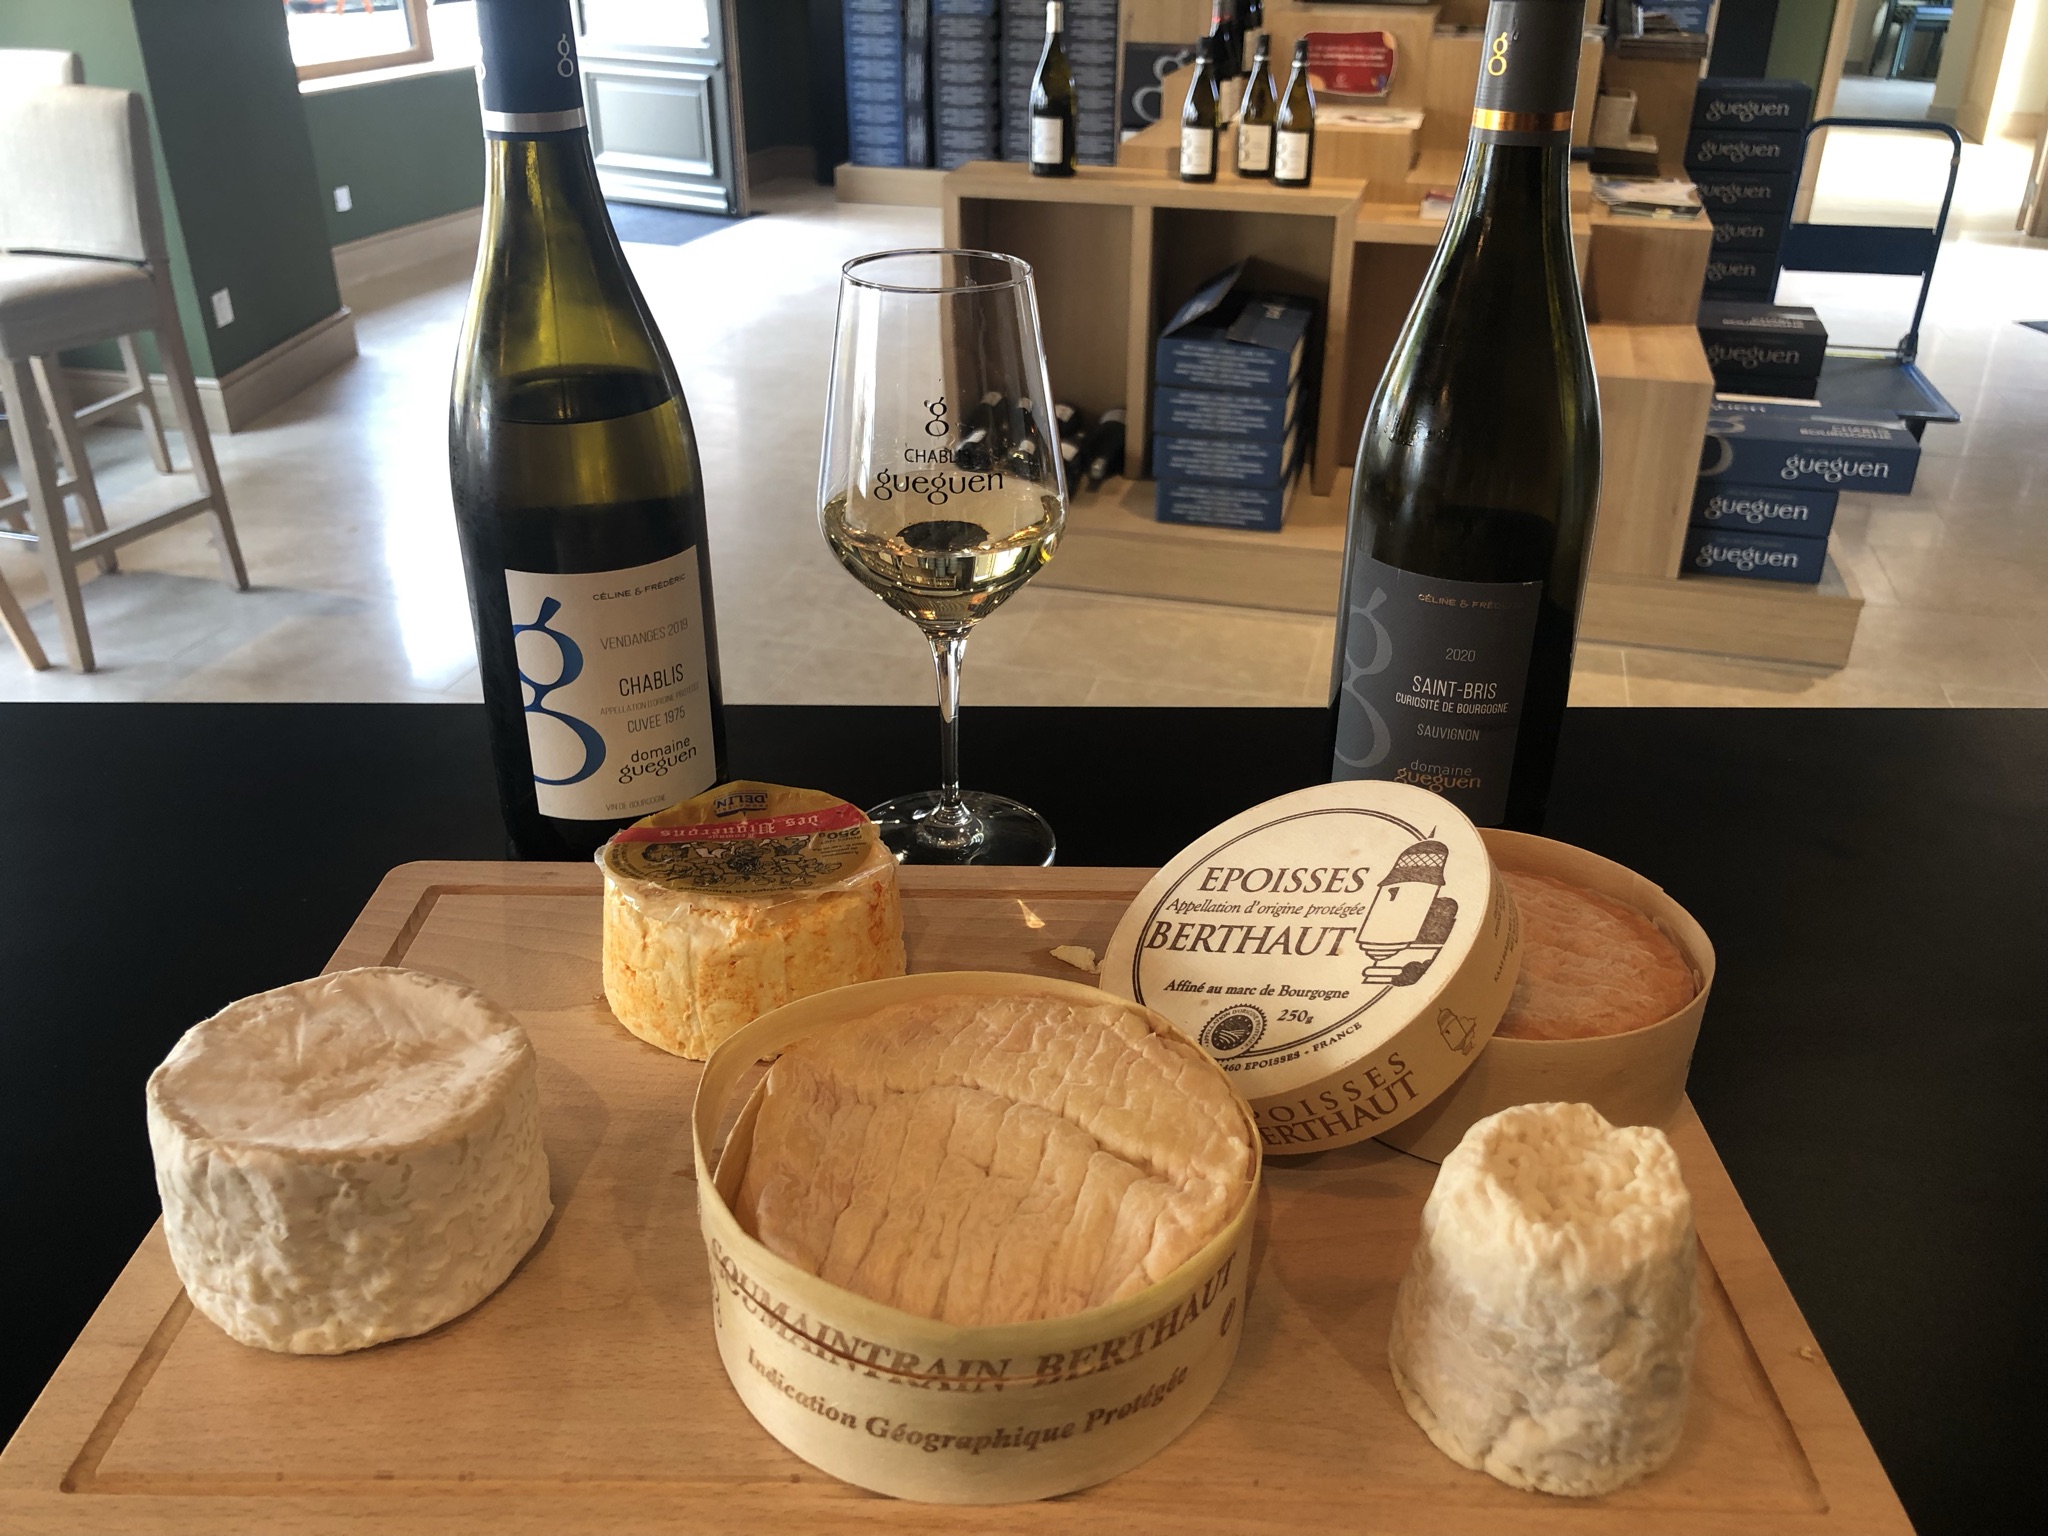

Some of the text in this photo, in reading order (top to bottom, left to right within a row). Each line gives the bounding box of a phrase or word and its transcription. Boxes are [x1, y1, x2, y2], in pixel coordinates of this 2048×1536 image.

[1706, 99, 1790, 122] gueguen
[1697, 140, 1780, 163] gueguen
[1700, 181, 1771, 203] ueguen
[1714, 222, 1764, 243] guen
[1707, 260, 1756, 281] guen
[904, 448, 964, 463] CHABL
[1781, 453, 1889, 483] gueguen
[873, 468, 1003, 505] gueguen
[1704, 494, 1809, 524] gueguen
[1696, 544, 1799, 571] gueguen
[592, 573, 686, 601] CÉLINE & FRÉDÉRIC
[1418, 593, 1456, 607] CÉLINE
[1460, 600, 1469, 608] &
[600, 617, 689, 651] VENDANGES 2019
[1445, 648, 1476, 662] 2020
[619, 663, 684, 697] CHABLIS
[1412, 675, 1497, 700] SAINT-BRIS
[1395, 692, 1508, 715] CURIOSITÉ DE BOURGOGNE
[628, 705, 686, 734] CUVEE 1975
[1416, 723, 1480, 741] SAUVIGNON
[631, 737, 690, 763] domaine
[618, 746, 697, 784] gueguen
[1410, 759, 1472, 777] domaine
[1394, 767, 1482, 793] gueguen
[716, 793, 767, 808] DELIN
[660, 814, 820, 837] des Vignerons
[818, 827, 861, 840] 250g
[1197, 867, 1370, 893] EPOISSES
[1166, 897, 1366, 918] Appellation d'origine protégée
[1144, 921, 1357, 957] BERTHAUT
[1163, 979, 1349, 1001] Affiné au marc de Bourgogne
[1277, 1009, 1314, 1025] 250g
[1220, 1063, 1242, 1073] 460
[1244, 1050, 1300, 1071] EPOISSES
[1312, 1022, 1363, 1052] FRANCE
[1253, 1051, 1406, 1122] OISSES
[1259, 1070, 1419, 1145] ERTHAUT
[712, 1238, 1237, 1392] SOUMAINTRAIN BERTHAUT
[748, 1345, 1190, 1456] Indication Géographique Protégée
